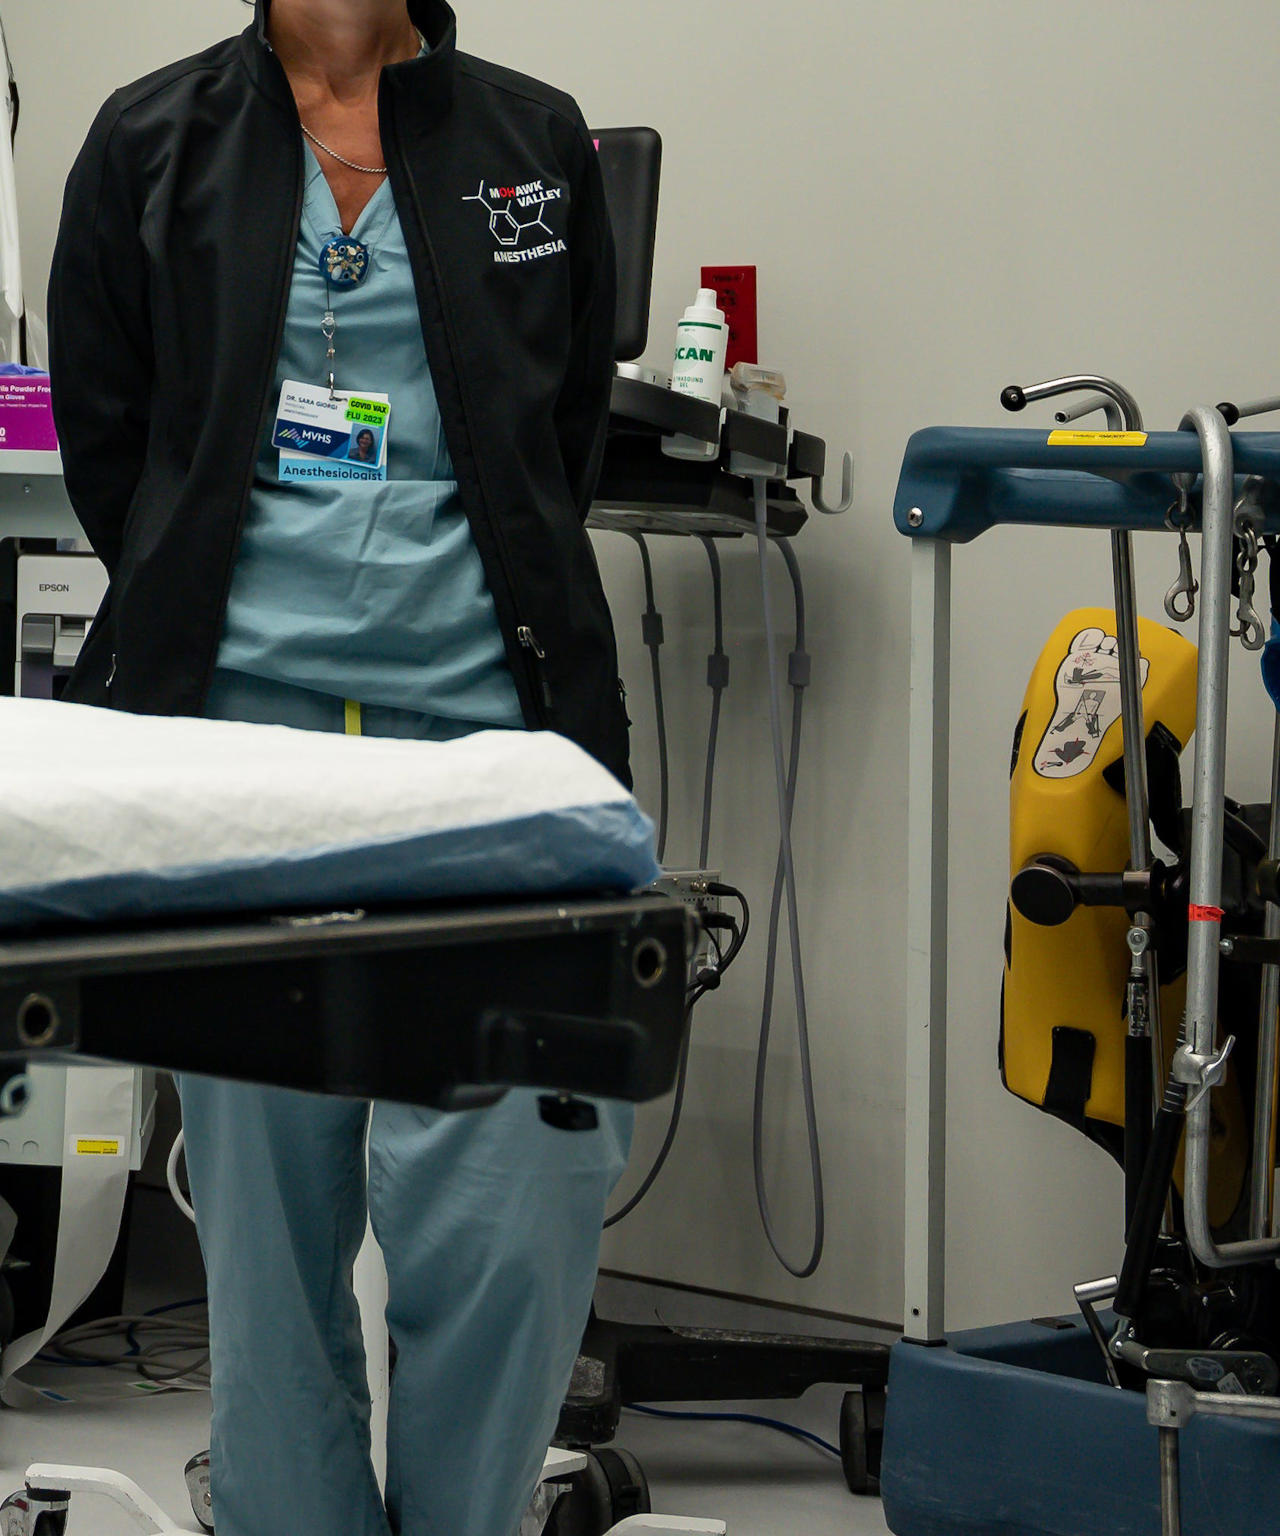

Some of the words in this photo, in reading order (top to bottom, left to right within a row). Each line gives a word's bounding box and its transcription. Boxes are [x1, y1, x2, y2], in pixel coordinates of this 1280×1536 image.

[489, 180, 543, 199] MOHAWK
[517, 188, 561, 207] VALLEY
[493, 239, 567, 262] ANESTHESIA
[298, 397, 315, 406] SARA
[316, 401, 338, 411] GIORGI
[350, 400, 372, 410] COVID
[373, 404, 387, 414] VAX
[346, 410, 361, 420] FLU
[363, 414, 382, 424] 2023
[302, 429, 332, 444] MVHS
[283, 465, 383, 481] Anesthesiologist
[39, 583, 69, 592] EPSON
